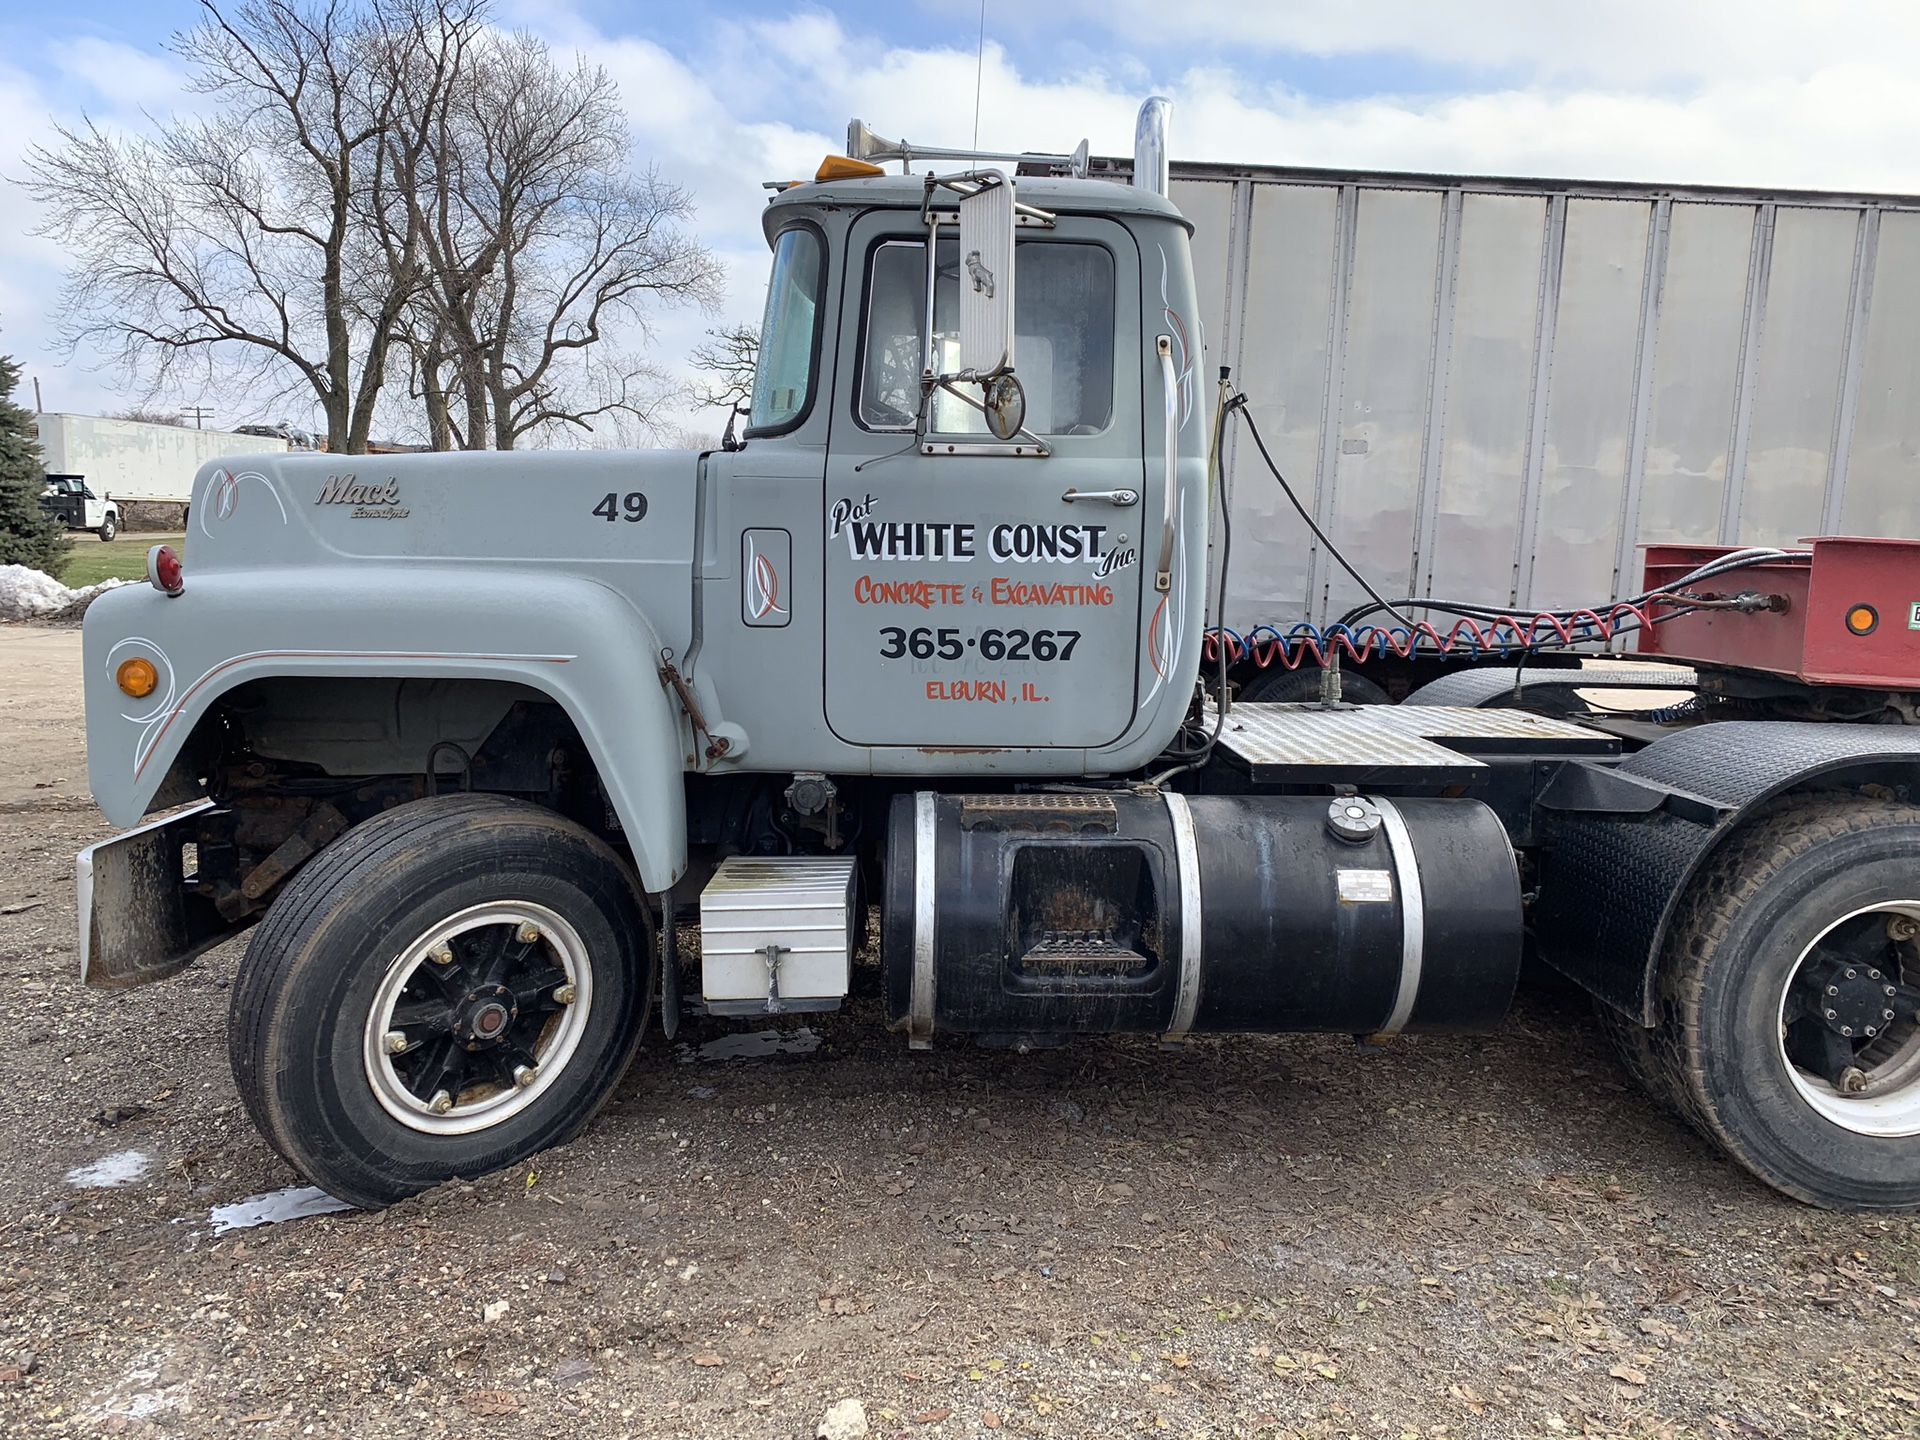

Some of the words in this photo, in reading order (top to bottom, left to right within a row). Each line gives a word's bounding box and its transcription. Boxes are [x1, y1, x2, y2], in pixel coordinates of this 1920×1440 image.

[314, 473, 401, 505] Mack
[592, 492, 649, 522] 49
[831, 494, 878, 538] Pat
[850, 522, 976, 562] WHITE
[1092, 546, 1137, 580] Inc.
[855, 575, 966, 609] CONCRETE
[972, 586, 984, 601] &
[991, 577, 1114, 606] EXCAVATING
[1022, 684, 1050, 703] IL.
